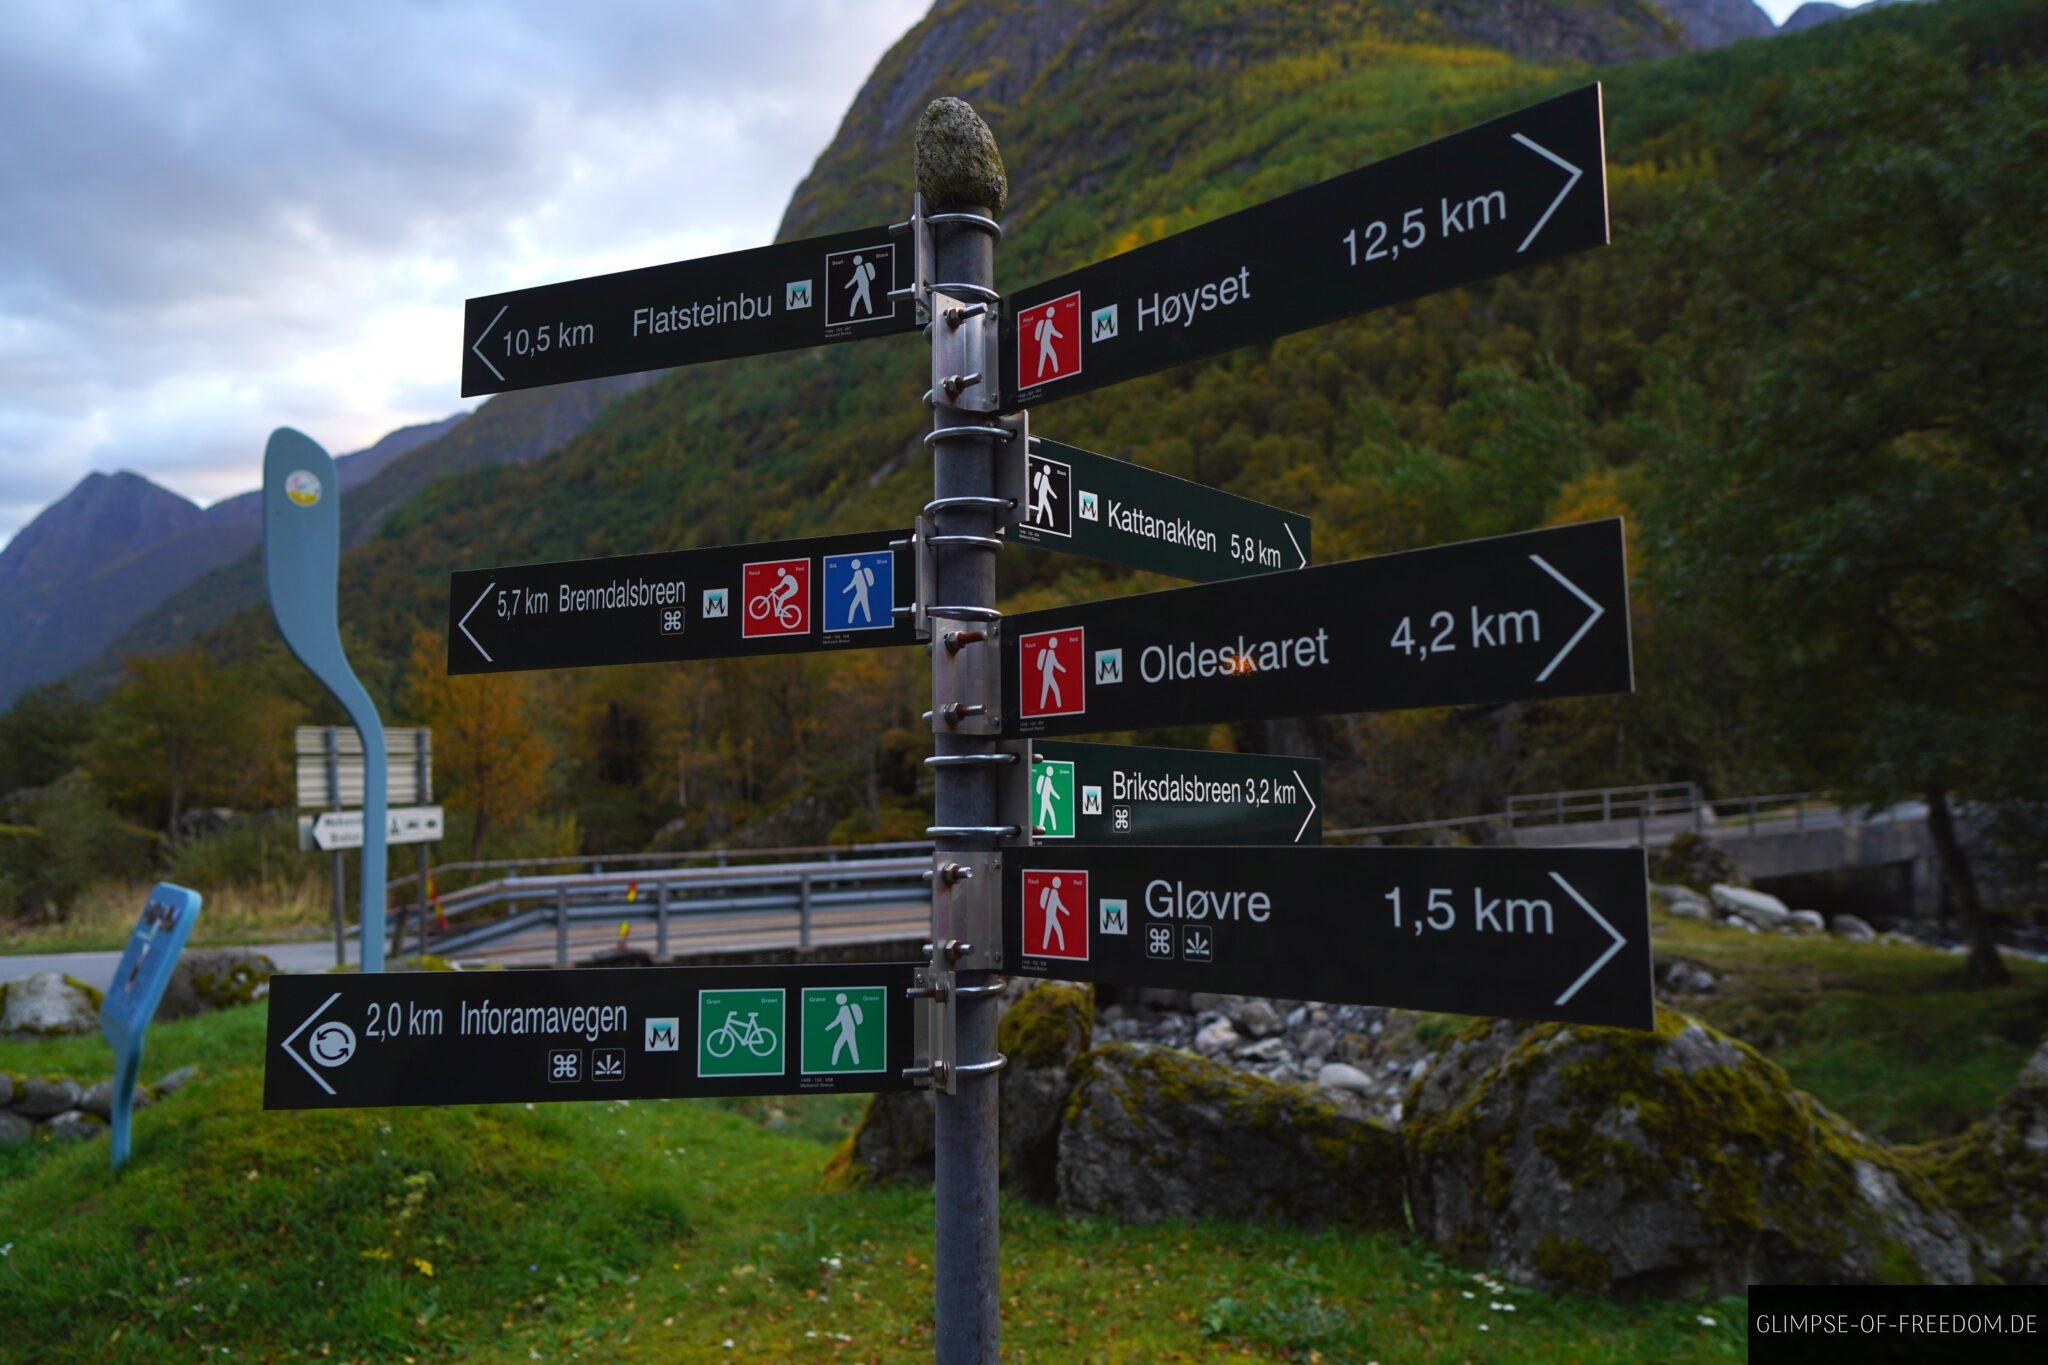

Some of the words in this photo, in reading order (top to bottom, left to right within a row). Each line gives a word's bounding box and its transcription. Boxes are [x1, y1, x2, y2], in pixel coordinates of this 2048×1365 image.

[1138, 266, 1250, 331] Høyset
[1343, 208, 1425, 265] 12,5
[1442, 191, 1506, 237] km
[503, 326, 550, 357] 10,5
[559, 322, 593, 348] km
[634, 292, 771, 337] Flatsteinbu
[1108, 500, 1216, 553] Kattanakken
[1230, 534, 1254, 564] 5,8
[1259, 540, 1280, 568] km
[497, 589, 521, 618] 5,7
[526, 587, 548, 614] km
[560, 578, 685, 613] Brenndalsbreen
[1140, 627, 1329, 683] Oldeskaret
[1391, 611, 1455, 661] 4,2
[1472, 606, 1540, 648] km
[1113, 771, 1241, 803] Briksdalsbreen
[1246, 778, 1270, 807] 3,2
[1274, 779, 1297, 804] km
[1145, 879, 1271, 923] Gløvre
[1385, 887, 1455, 936] 1,5
[1475, 887, 1553, 934] km
[365, 1001, 401, 1042] 2,0
[409, 1001, 443, 1036] km
[460, 999, 627, 1041] Inforamavegen
